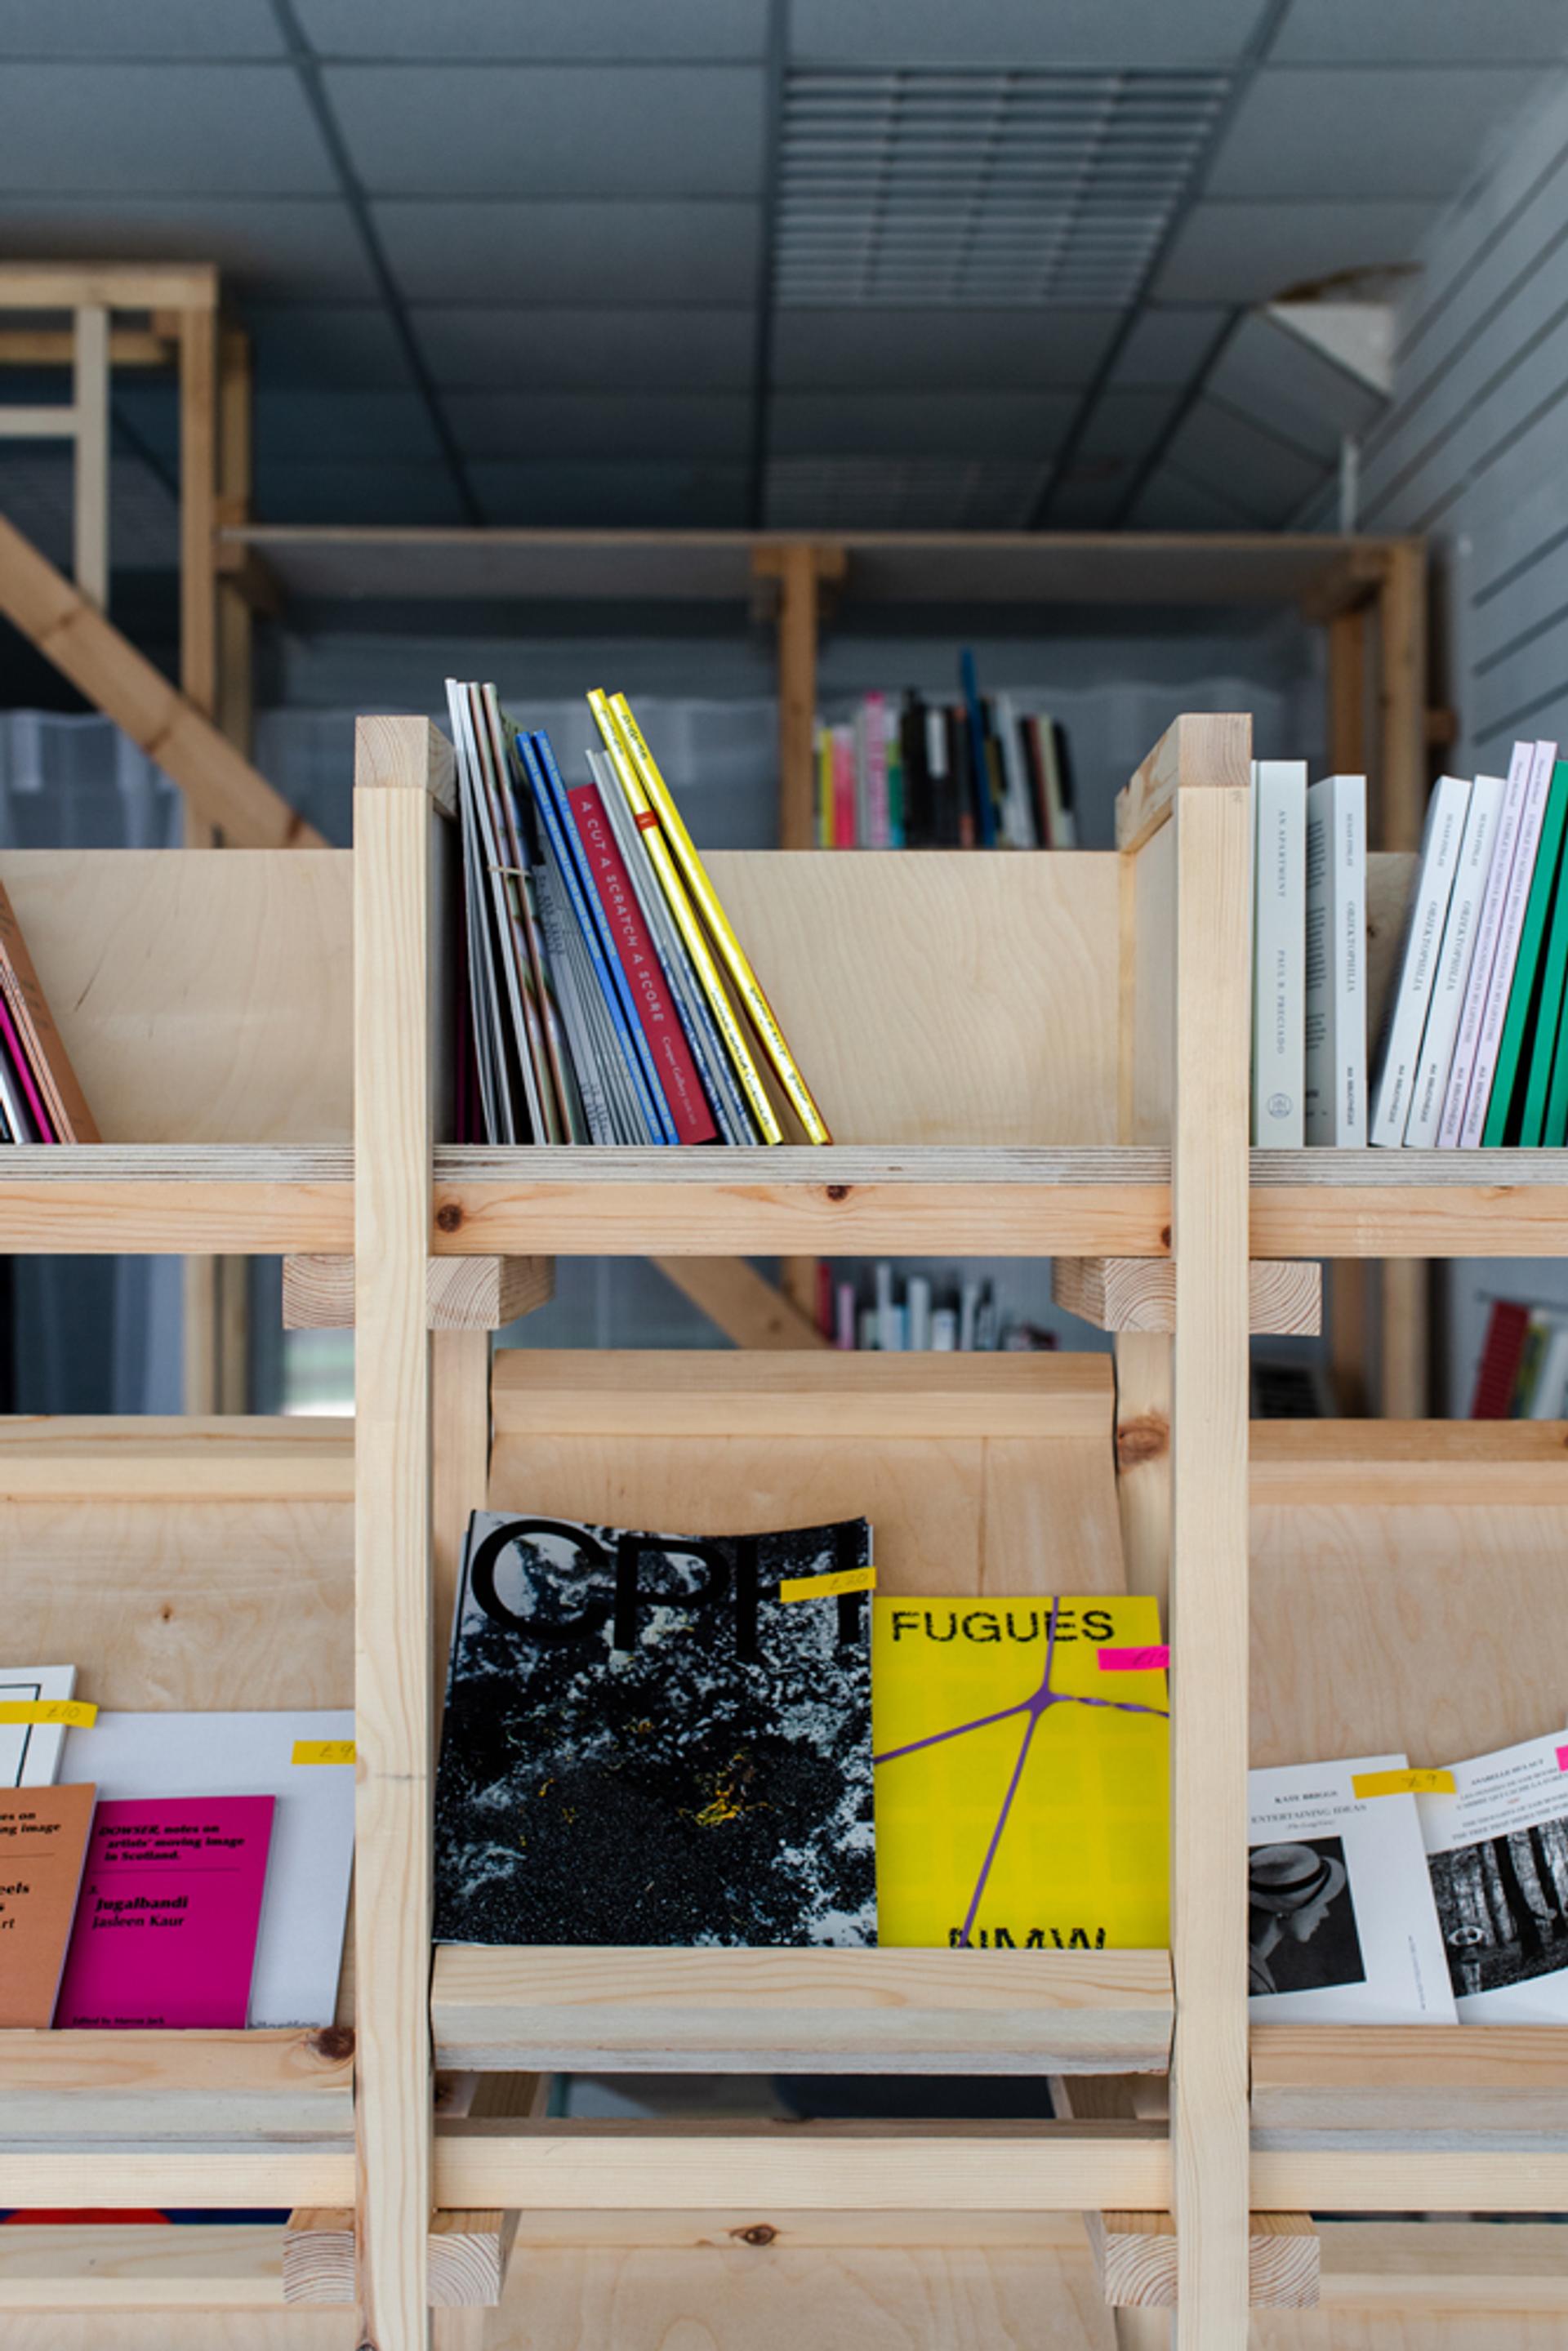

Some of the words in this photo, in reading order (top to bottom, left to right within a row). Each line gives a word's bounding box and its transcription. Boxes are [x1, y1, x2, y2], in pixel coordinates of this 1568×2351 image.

[579, 799, 593, 813] A
[585, 816, 608, 853] CUT
[598, 855, 612, 869] A
[1277, 829, 1286, 897] APARTMENT
[603, 872, 640, 948] SCRATCH
[630, 951, 645, 964] A
[635, 968, 666, 1023] SCORE
[1276, 995, 1285, 1054] PRECIADO
[891, 1610, 1115, 1643] FUGUES
[21, 1823, 61, 1835] image
[164, 1825, 198, 1834] notes
[154, 1837, 202, 1848] moving
[206, 1837, 244, 1847] image
[95, 1896, 188, 1912] Jugalbandi
[92, 1917, 145, 1929] Jasleen
[149, 1915, 185, 1927] Kaur
